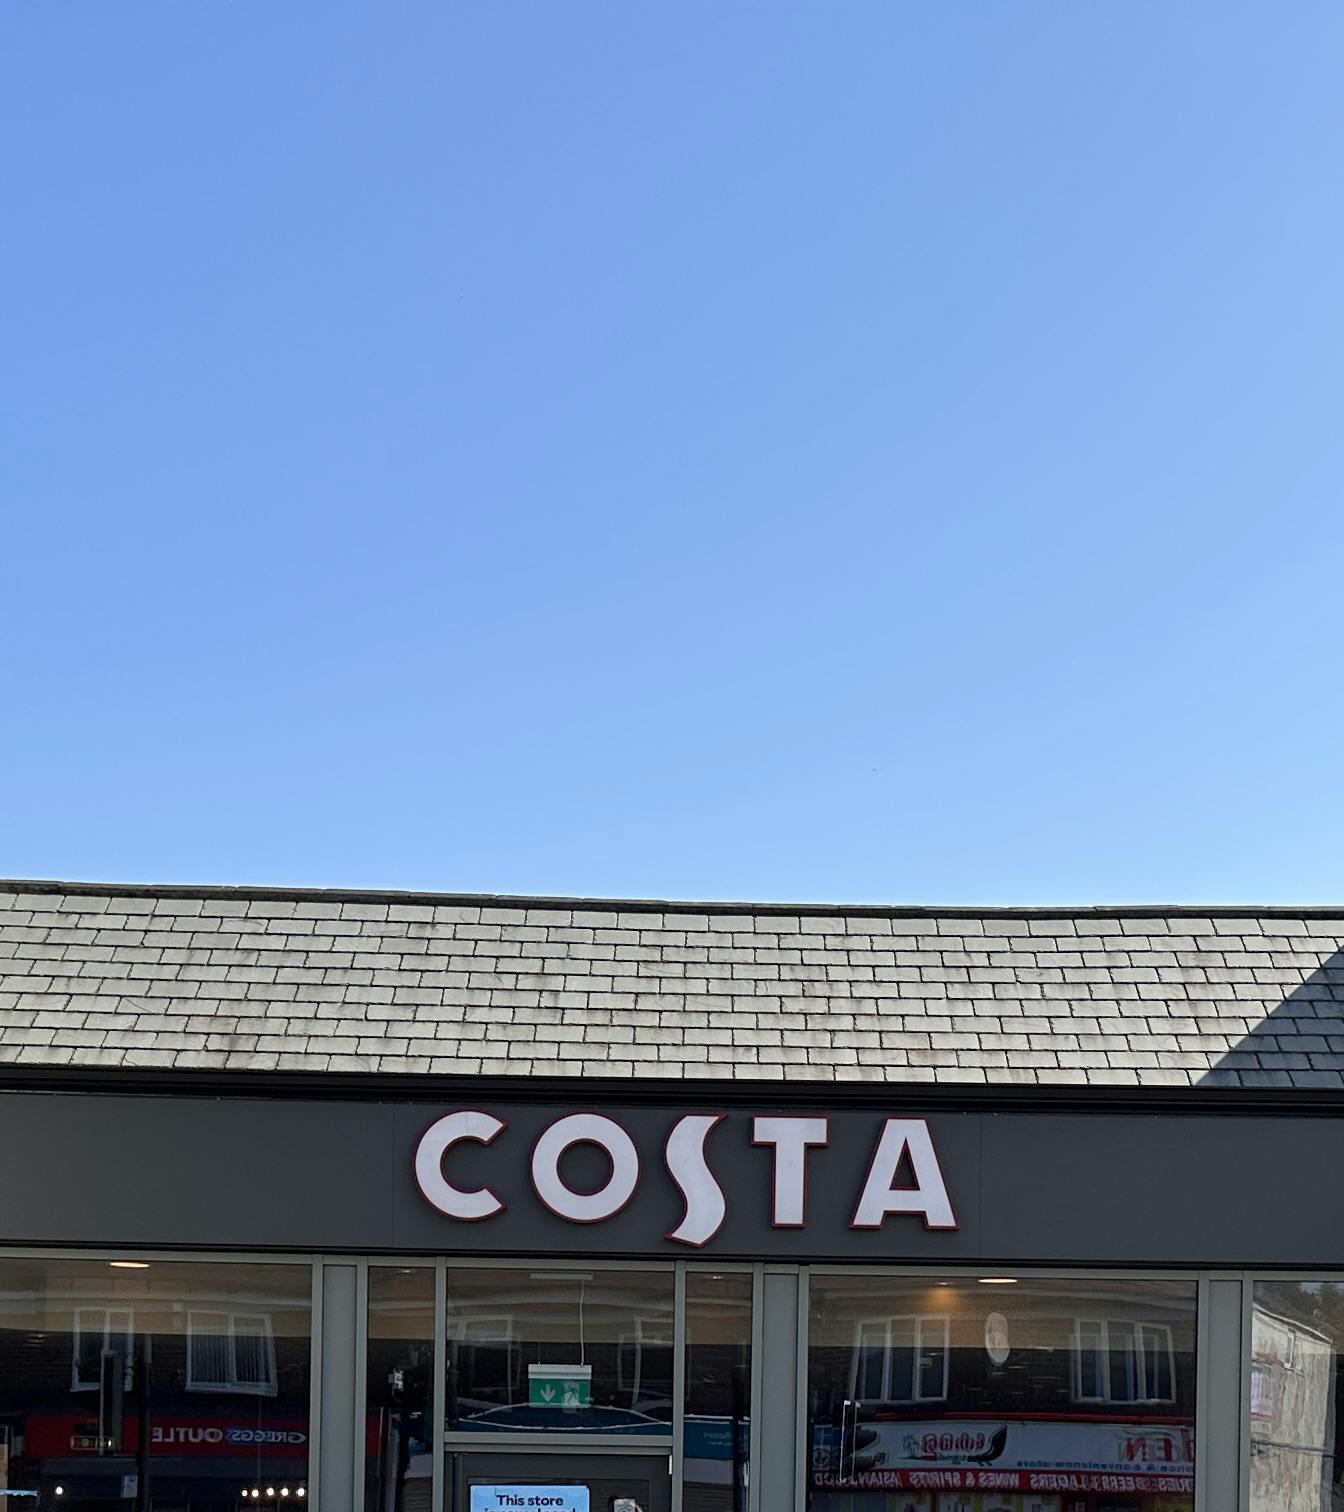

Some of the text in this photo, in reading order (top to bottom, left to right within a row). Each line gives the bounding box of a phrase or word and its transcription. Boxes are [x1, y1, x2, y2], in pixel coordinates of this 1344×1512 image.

[413, 1110, 959, 1248] COSTA
[496, 1494, 564, 1506] This store
